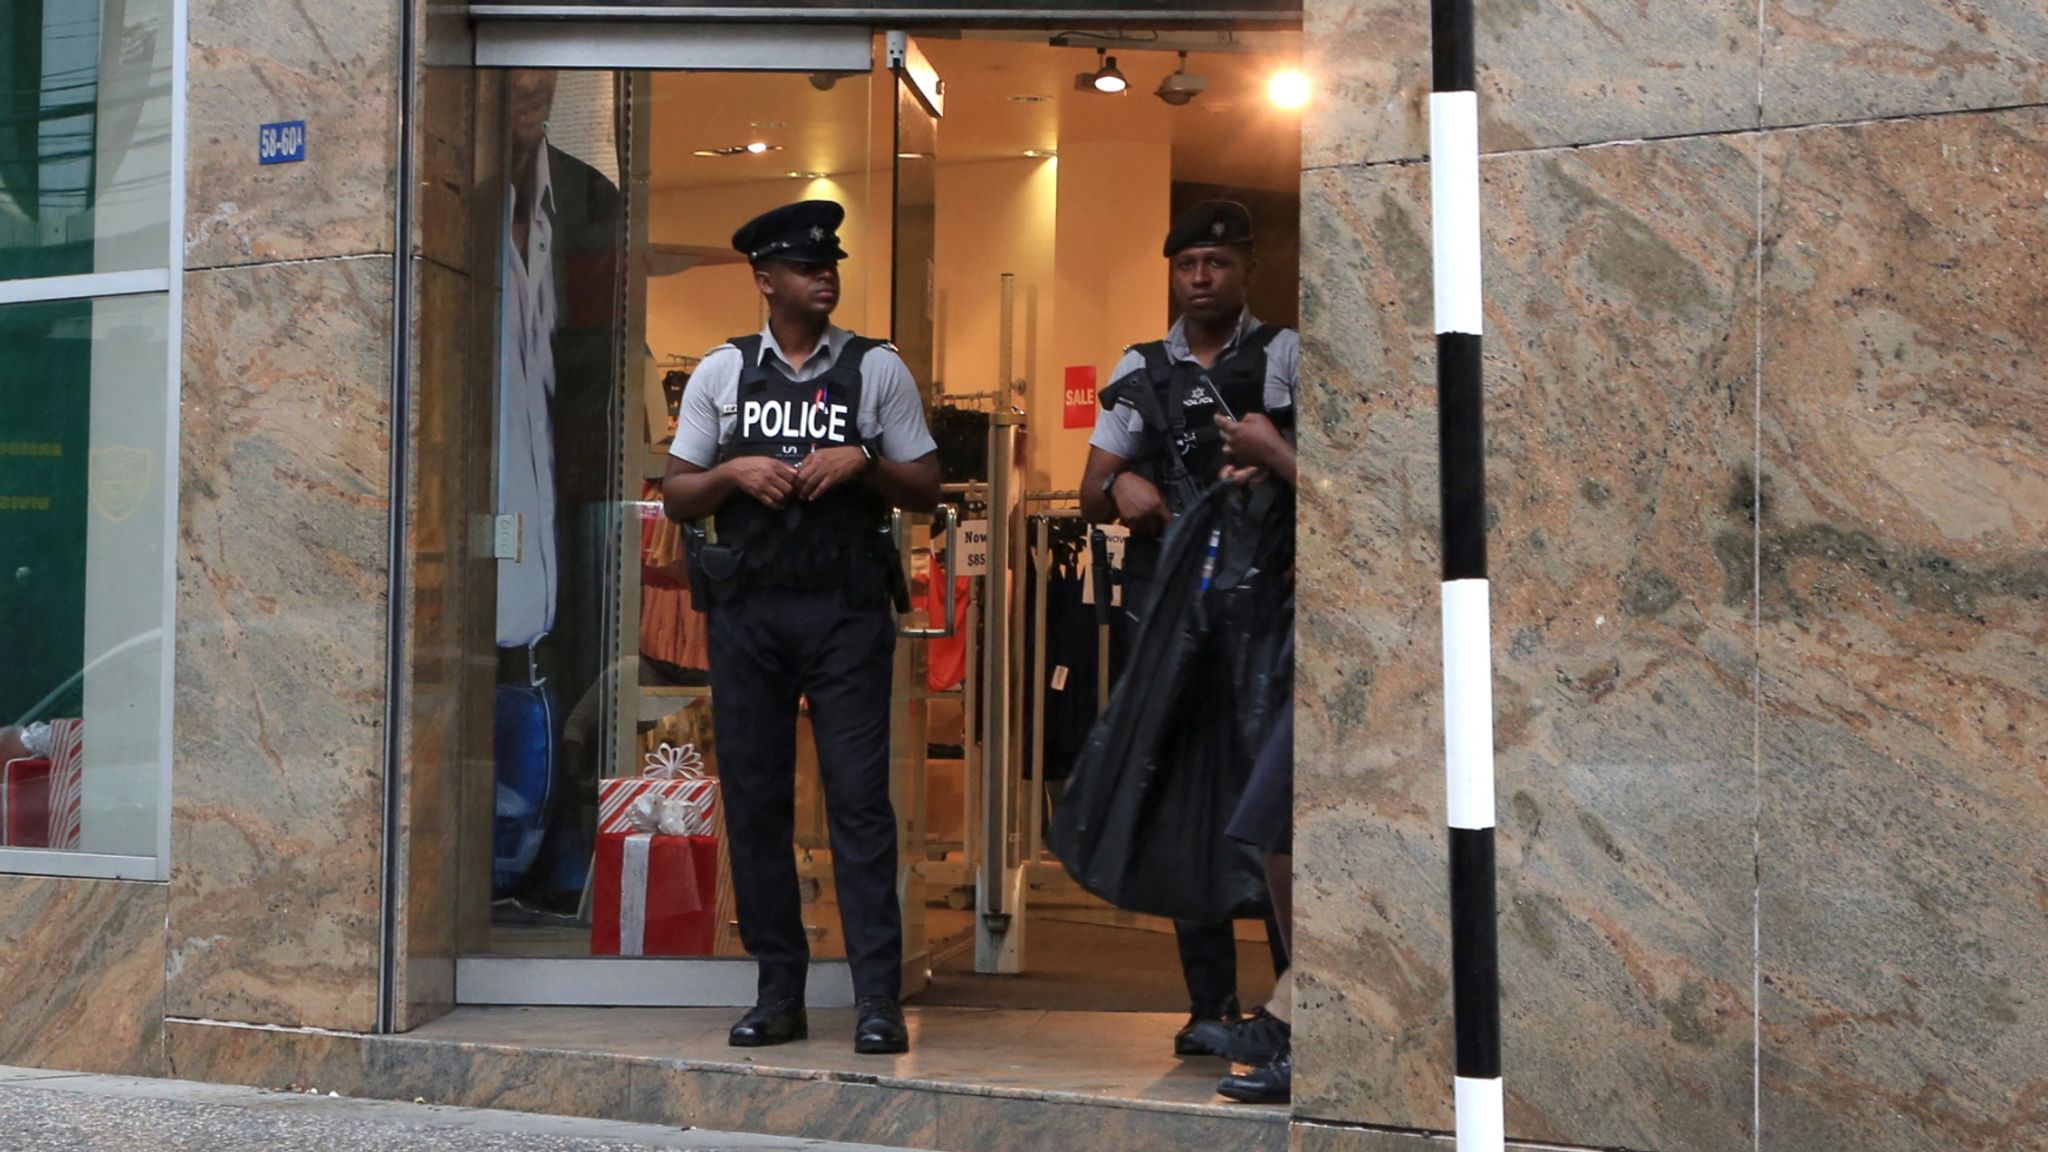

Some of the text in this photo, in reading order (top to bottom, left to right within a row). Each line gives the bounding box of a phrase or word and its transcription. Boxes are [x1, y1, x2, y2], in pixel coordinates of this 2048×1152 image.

[261, 127, 303, 158] 58-60A
[1065, 389, 1094, 406] SALE
[743, 400, 848, 442] POLICE
[967, 553, 986, 567] $85
